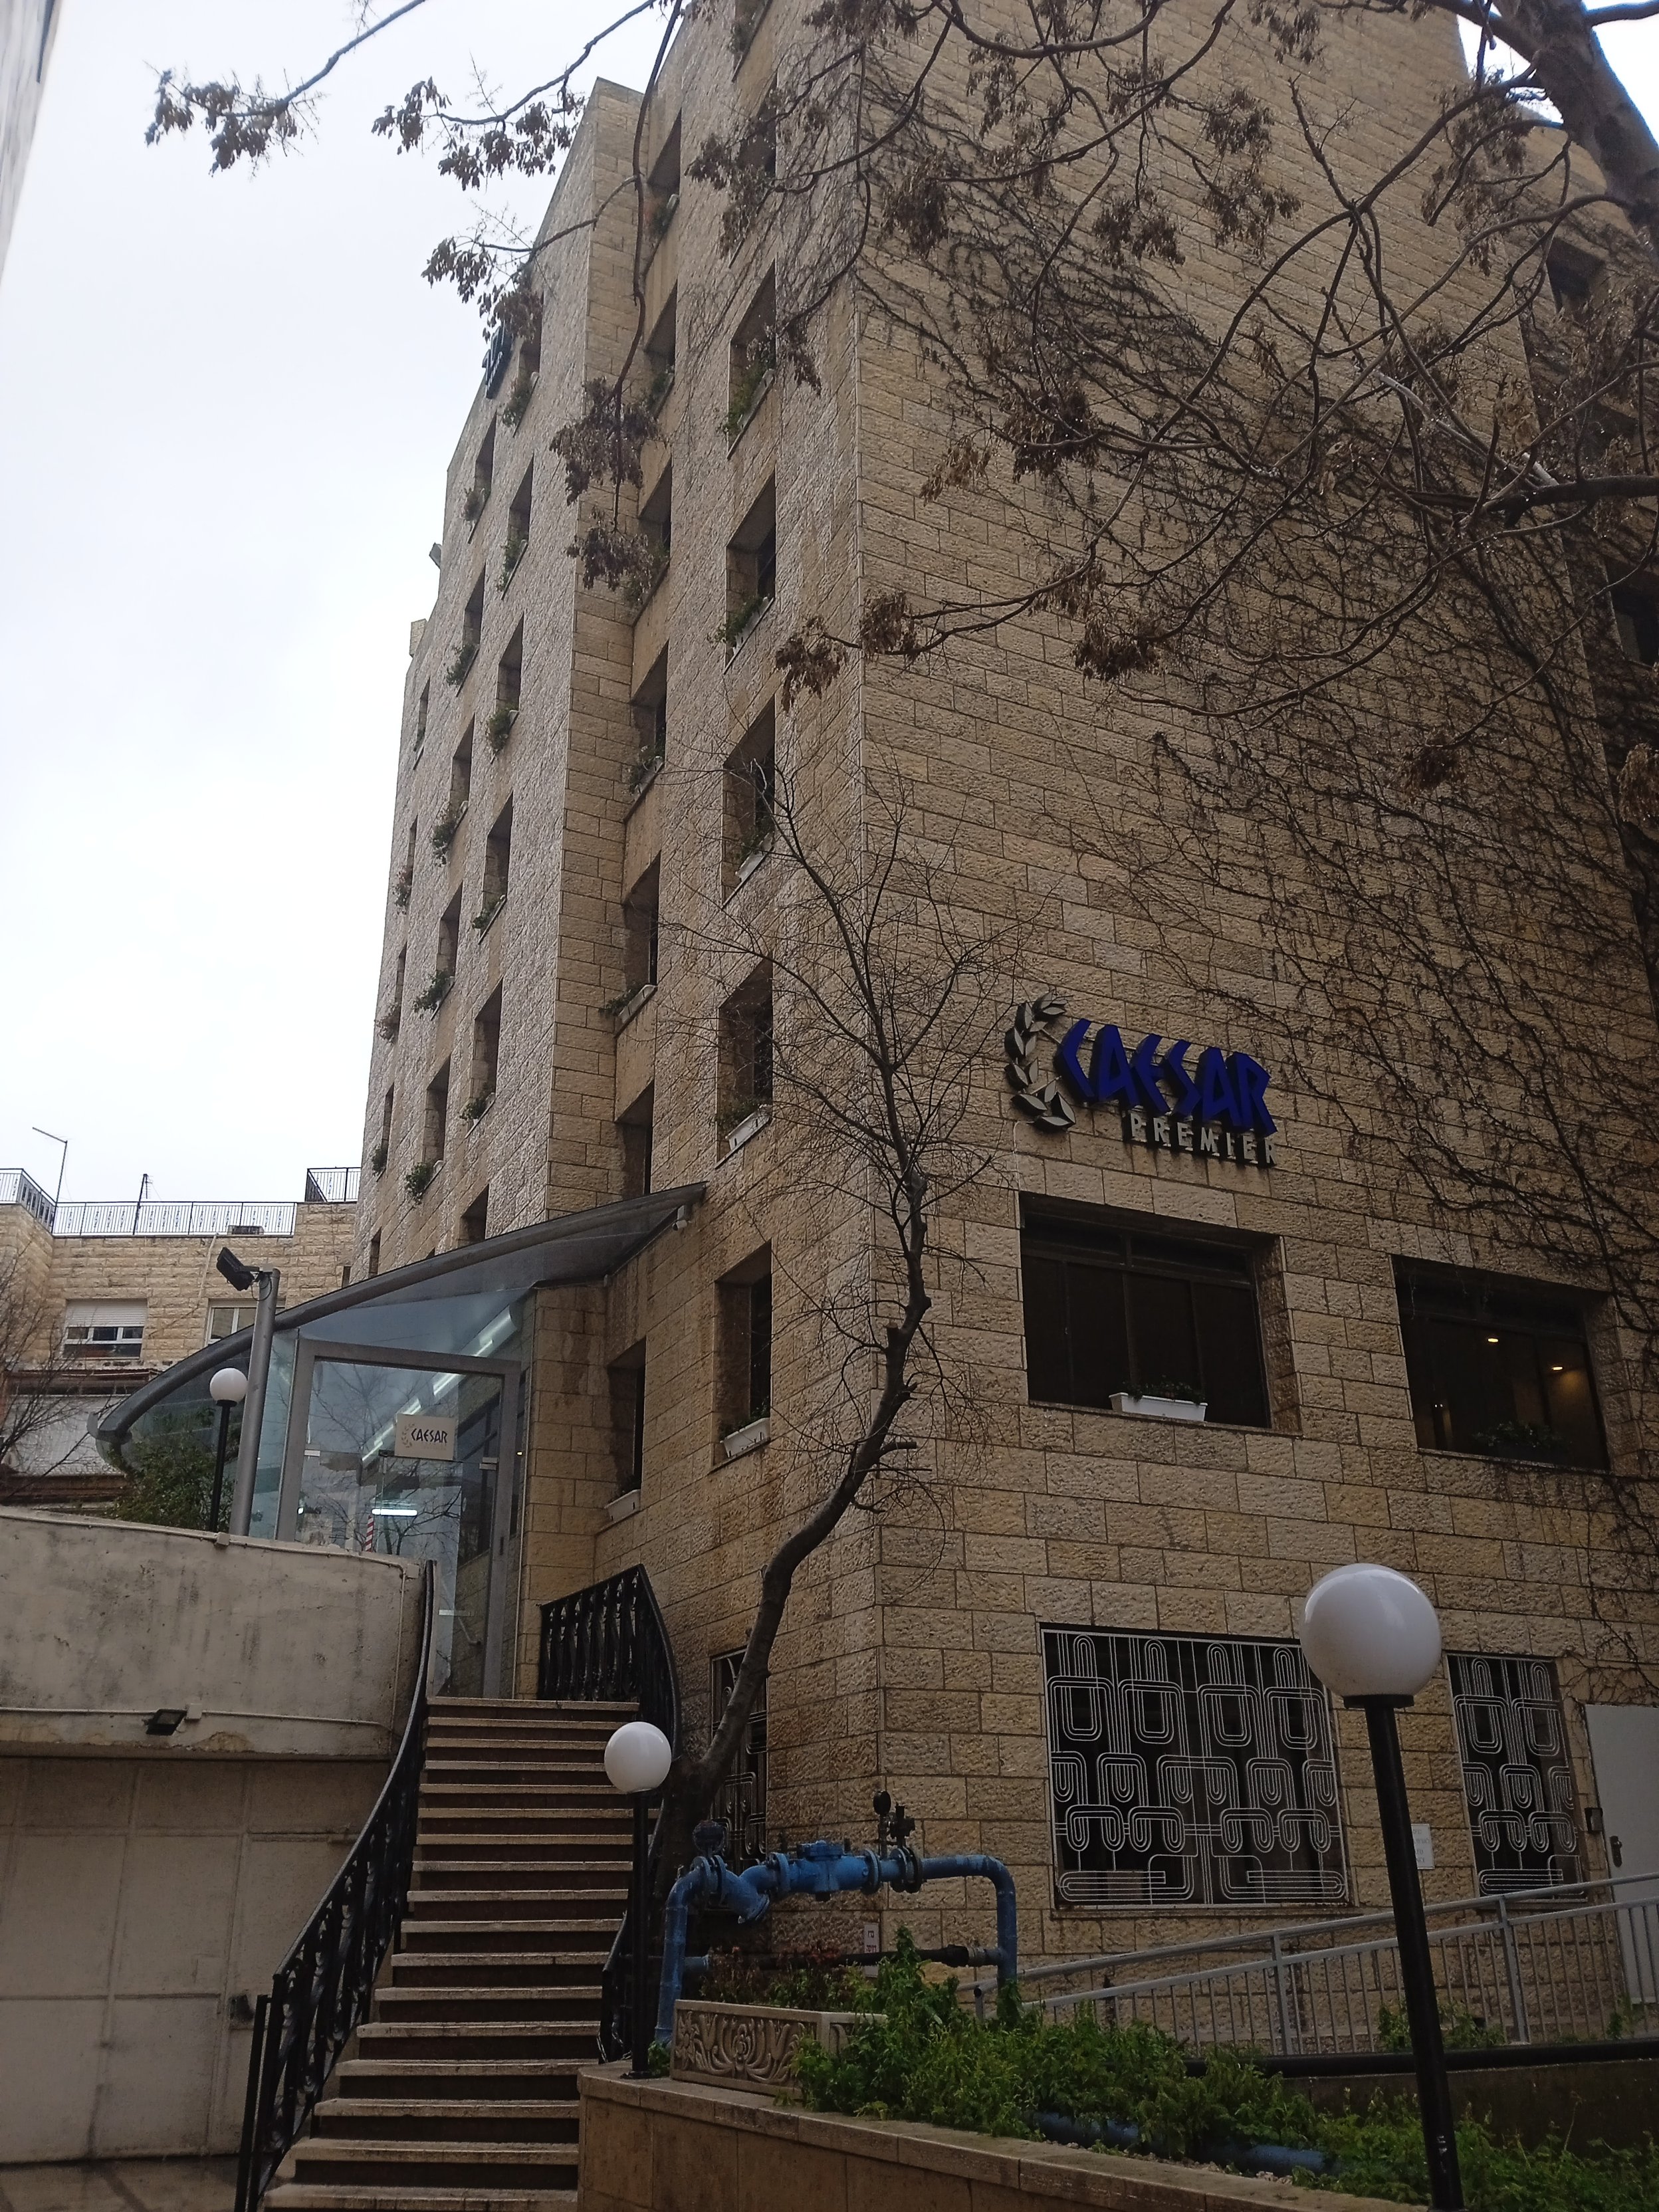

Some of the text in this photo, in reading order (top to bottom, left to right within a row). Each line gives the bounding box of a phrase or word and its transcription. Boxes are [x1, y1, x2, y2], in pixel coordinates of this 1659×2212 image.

[1056, 1018, 1277, 1137] CAESAR
[1129, 1113, 1277, 1164] PREMIER
[411, 1428, 447, 1443] CAESAR
